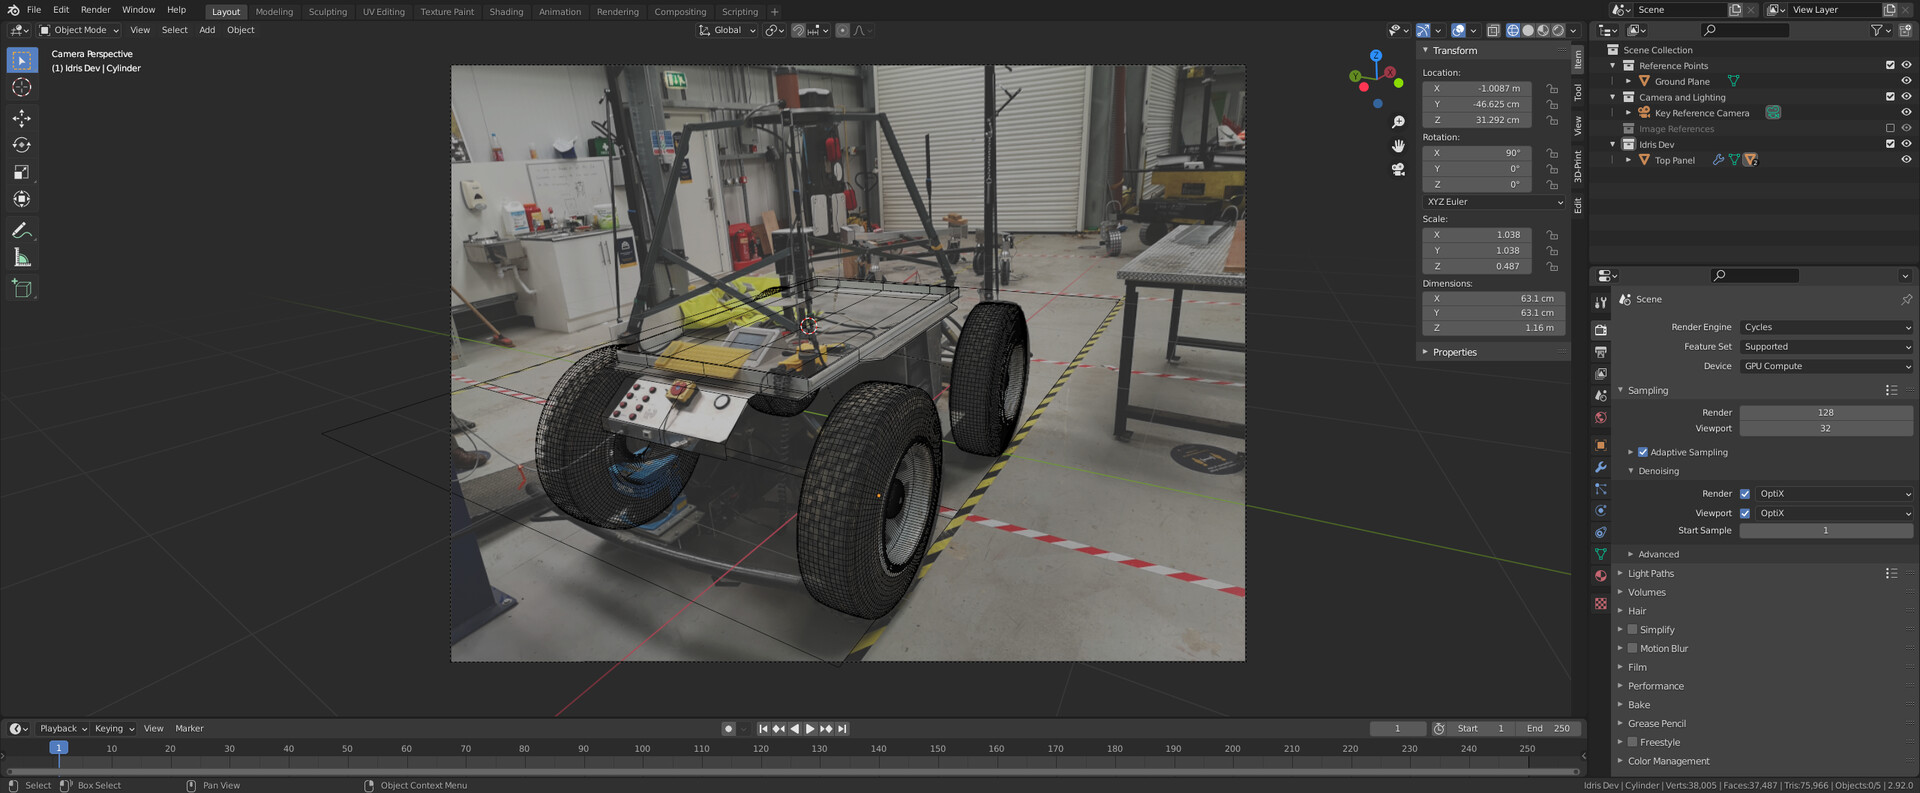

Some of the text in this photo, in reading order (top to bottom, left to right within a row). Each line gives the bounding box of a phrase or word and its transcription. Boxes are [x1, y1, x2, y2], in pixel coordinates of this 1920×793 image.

[27, 5, 42, 14] File
[53, 5, 70, 14] Edit
[81, 5, 112, 14] Render
[122, 5, 156, 14] Window
[167, 5, 187, 15] Help
[212, 8, 241, 18] Layout
[255, 7, 294, 18] Modeling
[308, 7, 348, 18] Sculpting
[362, 7, 406, 18] UV Editing
[420, 7, 475, 16] Texture Paint
[489, 7, 524, 18] Shading
[538, 7, 582, 16] Animation
[597, 7, 640, 18] Rendering
[654, 7, 707, 18] Compositing
[722, 7, 759, 18] Scripting
[1638, 5, 1665, 14] Scene
[1792, 5, 1839, 16] View Layer
[54, 25, 107, 36] Object Mode
[130, 25, 151, 34] View
[161, 25, 189, 34] Select
[198, 25, 216, 34] Add
[226, 25, 255, 36] Object
[714, 25, 742, 34] Global
[51, 49, 134, 60] Camera Perspective
[1432, 46, 1478, 55] Transform
[1623, 46, 1694, 55] Scene Collection
[1574, 50, 1582, 70] Item
[51, 64, 142, 74] (1) Idris Dev Cylinder
[1639, 61, 1709, 70] Reference Points
[1422, 68, 1461, 77] Location:
[1654, 77, 1711, 86] Ground Plane
[1478, 84, 1510, 93] -1.0087
[1573, 83, 1582, 102] Tool
[1639, 93, 1726, 104] Camera and Lighting
[1473, 100, 1505, 108] -46.625
[1654, 109, 1750, 119] Key Reference Camera
[1476, 115, 1505, 124] 31.292
[1573, 115, 1582, 137] View
[1639, 124, 1715, 135] Image References
[1422, 133, 1460, 142] Rotation:
[1639, 140, 1675, 149] Idris Dev
[1654, 156, 1696, 166] Top Panel
[1573, 150, 1582, 183] 3D-Print
[1427, 197, 1469, 206] XYZ Euler
[1573, 197, 1582, 214] Edit
[1422, 214, 1448, 223] Scale:
[1497, 230, 1521, 239] 1.038
[1496, 246, 1520, 255] 1.038
[1496, 262, 1520, 271] 0.487
[1422, 279, 1473, 288] Dimensions:
[1520, 294, 1539, 303] 63.1
[1636, 295, 1663, 304] Scene
[1520, 308, 1539, 317] 63.1
[1526, 323, 1544, 332] 1.16
[1671, 322, 1732, 333] Render Engine
[1744, 322, 1773, 333] Cycles
[1684, 342, 1733, 351] Feature Set
[1745, 342, 1789, 352] Supported
[1433, 348, 1478, 359] Properties
[1704, 362, 1733, 370] Device
[1744, 361, 1803, 372] GPU Compute
[1628, 386, 1669, 397] Sampling
[1702, 408, 1733, 417] Render
[1818, 408, 1835, 417] 128
[1695, 424, 1732, 434] Viewport
[1820, 424, 1831, 433] 32
[1650, 448, 1729, 458] Adaptive Sampling
[1638, 466, 1680, 477] Denoising
[1702, 489, 1733, 498] Render
[1760, 489, 1785, 499] OptiX
[1695, 509, 1733, 519] Viewport
[1760, 508, 1785, 519] OptiX
[1678, 526, 1733, 536] Start Sample
[1823, 526, 1829, 535] 1
[1638, 550, 1680, 559] Advanced
[1628, 569, 1675, 580] Light Paths
[1627, 588, 1667, 597] Volumes
[1628, 606, 1647, 616] Hair
[1640, 625, 1676, 636] Simplify
[1640, 644, 1689, 653] Motion Blur
[1628, 662, 1648, 672] Film
[1628, 681, 1685, 691] Performance
[1628, 700, 1651, 709] Bake
[1627, 719, 1687, 728] Grease Pencil
[40, 724, 77, 734] Playback
[95, 724, 124, 735] Keying
[143, 724, 165, 733] View
[175, 724, 204, 733] Marker
[1457, 724, 1479, 733] Start
[1527, 724, 1543, 733] End
[1554, 724, 1571, 733] 250
[1640, 738, 1681, 749] Freestyle
[342, 744, 354, 753] 50
[634, 744, 651, 753] 100
[1224, 744, 1241, 753] 200
[1519, 744, 1536, 753] 250
[1628, 756, 1711, 768] Color Management
[25, 781, 52, 790] Select
[78, 781, 122, 790] Box Select
[203, 781, 241, 790] Pan View
[380, 781, 468, 791] Object Context Menu
[1584, 781, 1914, 791] Idris Dev Cylinder Verts:38,005 Faces:37,487 Tris:75,966 Objects:0/5 2.92.0
